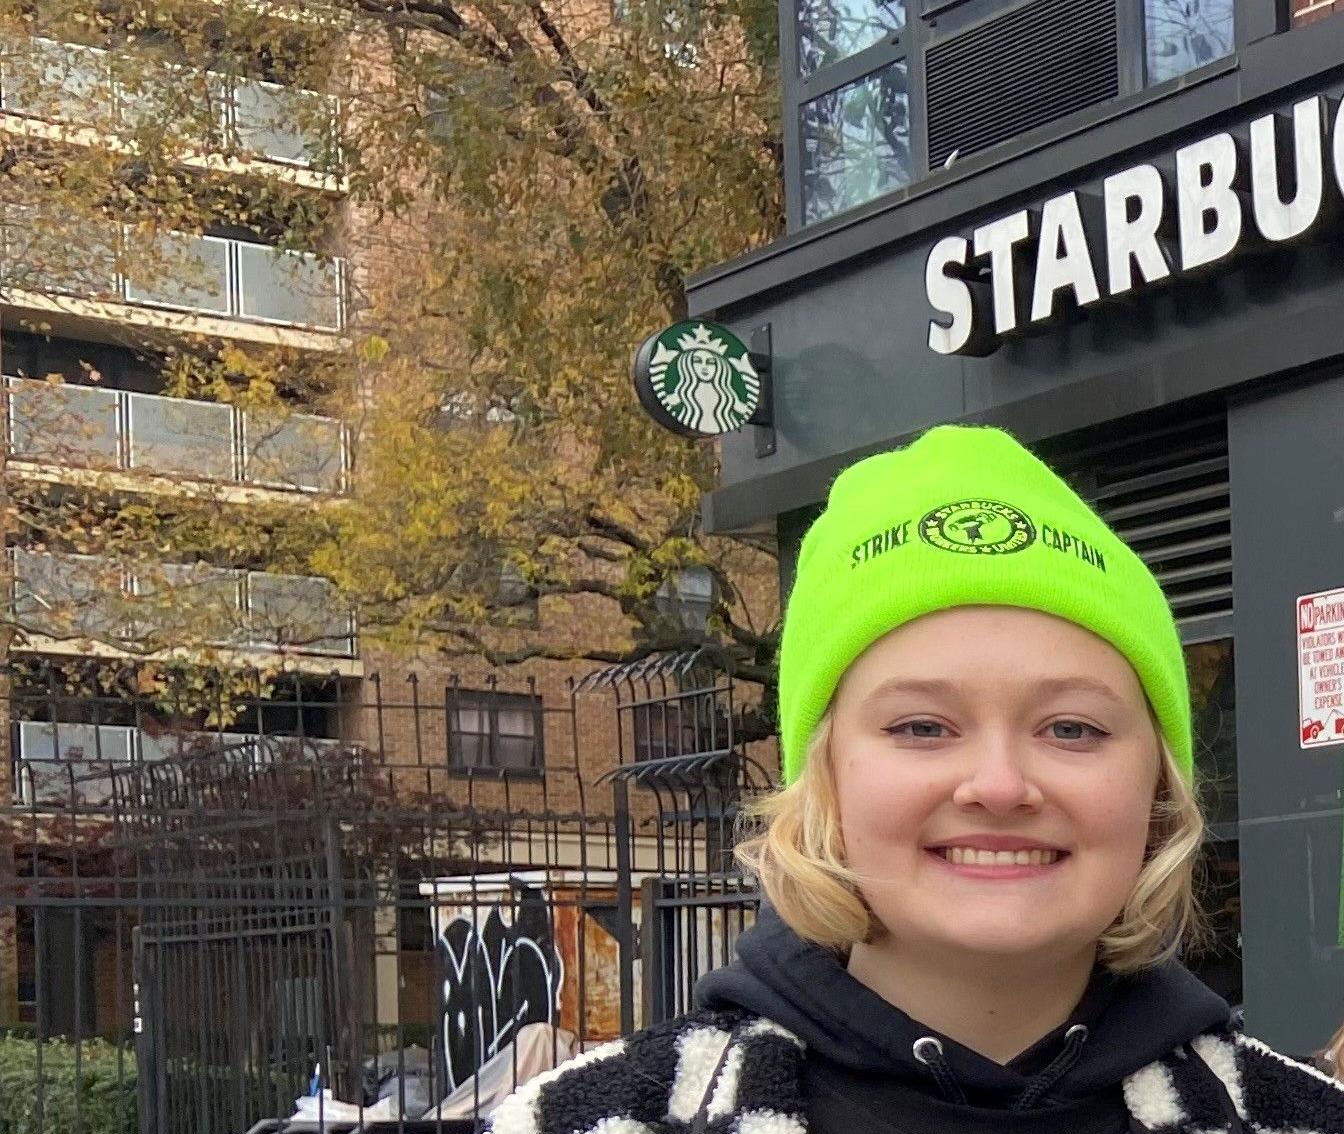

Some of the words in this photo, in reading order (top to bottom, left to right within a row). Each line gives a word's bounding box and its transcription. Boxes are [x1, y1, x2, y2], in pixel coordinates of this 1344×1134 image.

[851, 519, 912, 570] STRIKE
[1042, 524, 1107, 574] CAPTAIN
[1301, 603, 1313, 630] NO
